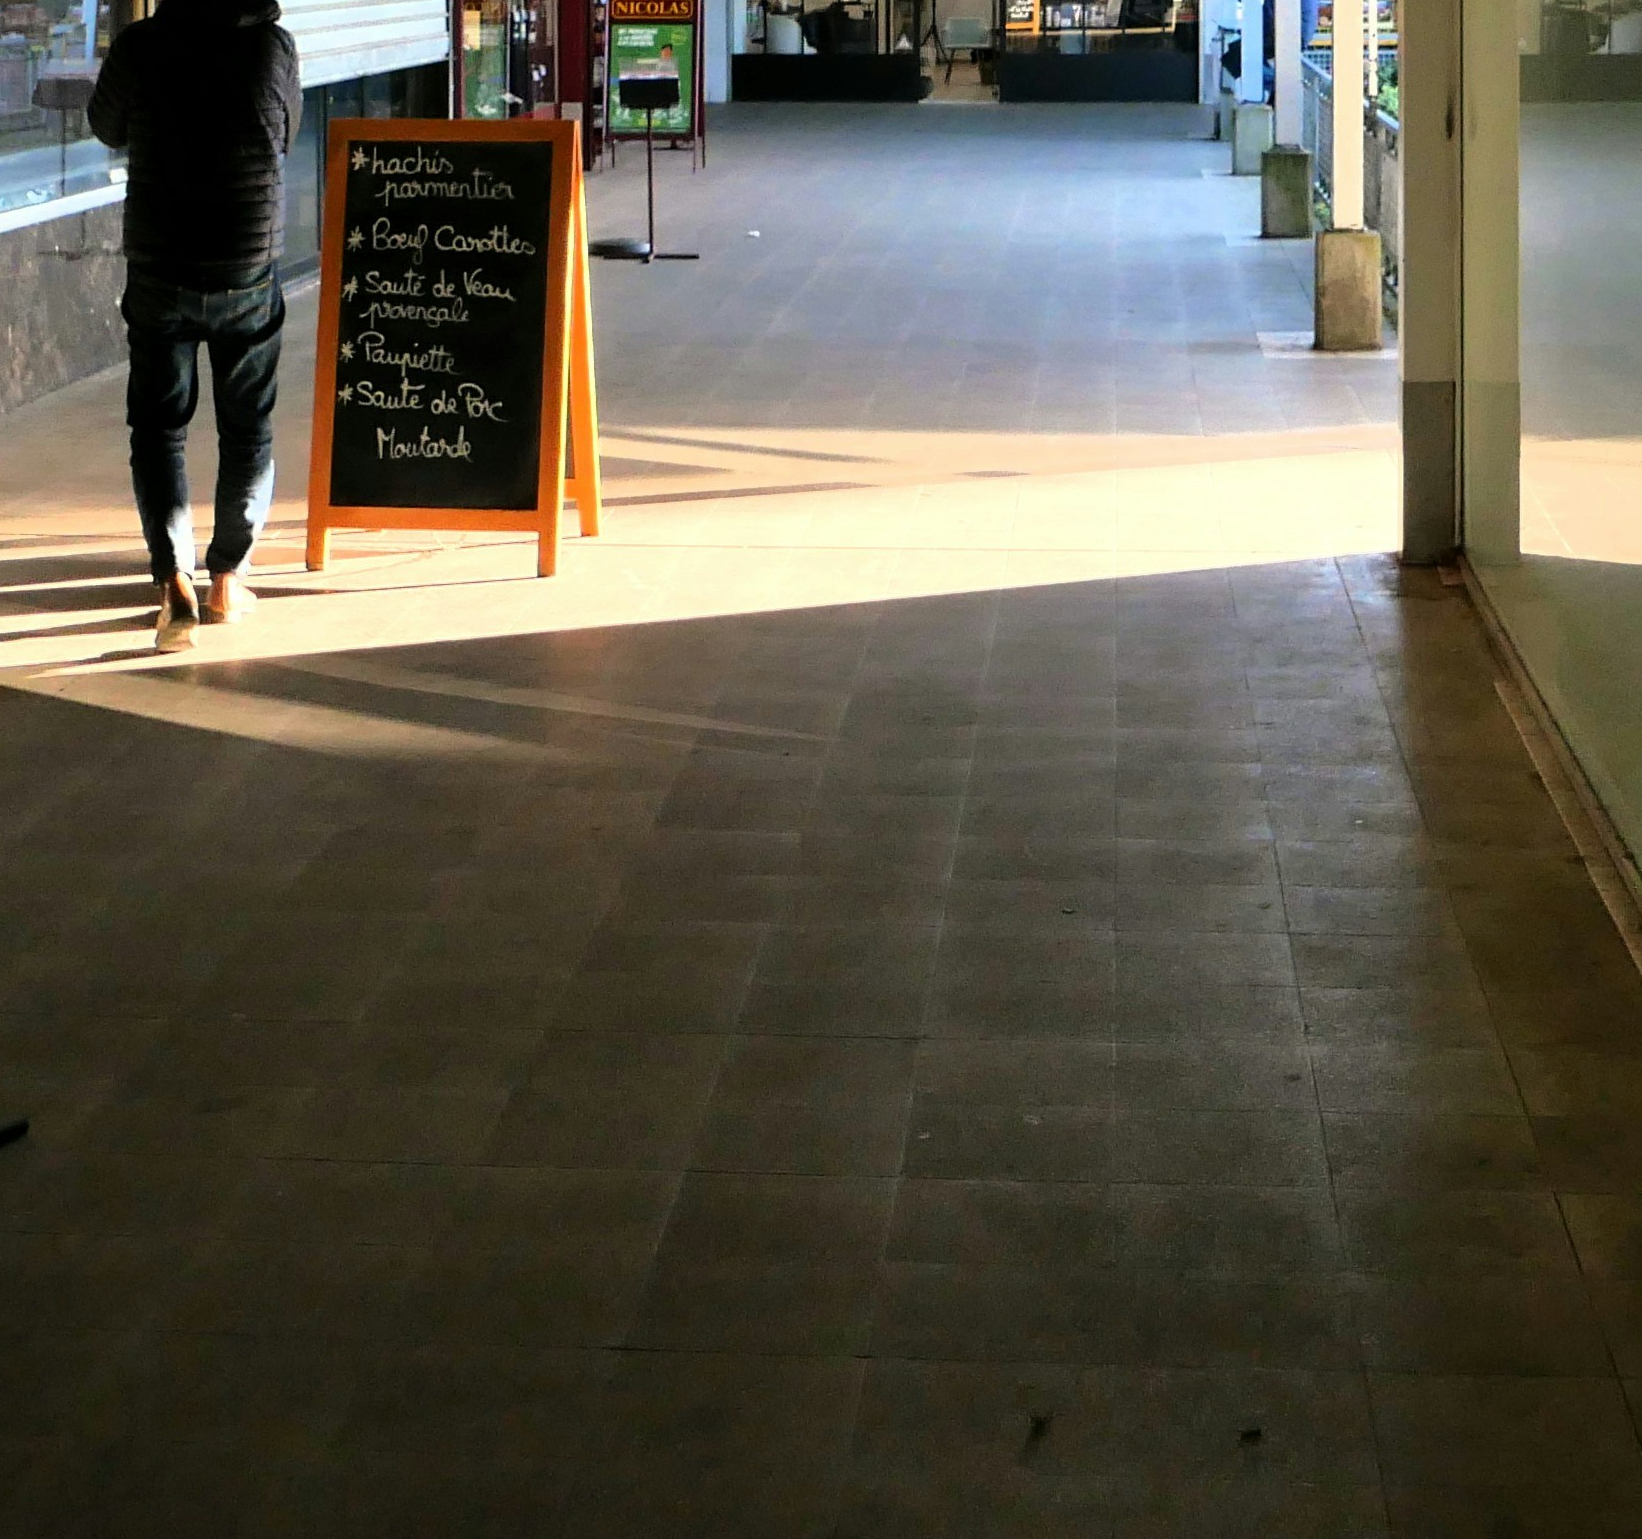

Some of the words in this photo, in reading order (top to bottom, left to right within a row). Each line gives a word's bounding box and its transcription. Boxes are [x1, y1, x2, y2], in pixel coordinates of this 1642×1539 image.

[617, 2, 690, 15] NICOLAS
[372, 146, 454, 174] hachis
[374, 167, 516, 207] parmentier
[434, 224, 536, 255] Carottes
[432, 269, 458, 298] de
[463, 268, 517, 302] Veau
[357, 331, 461, 377] Paupiette
[431, 390, 459, 414] de
[458, 382, 508, 422] Porc
[377, 425, 474, 462] Moutarde
